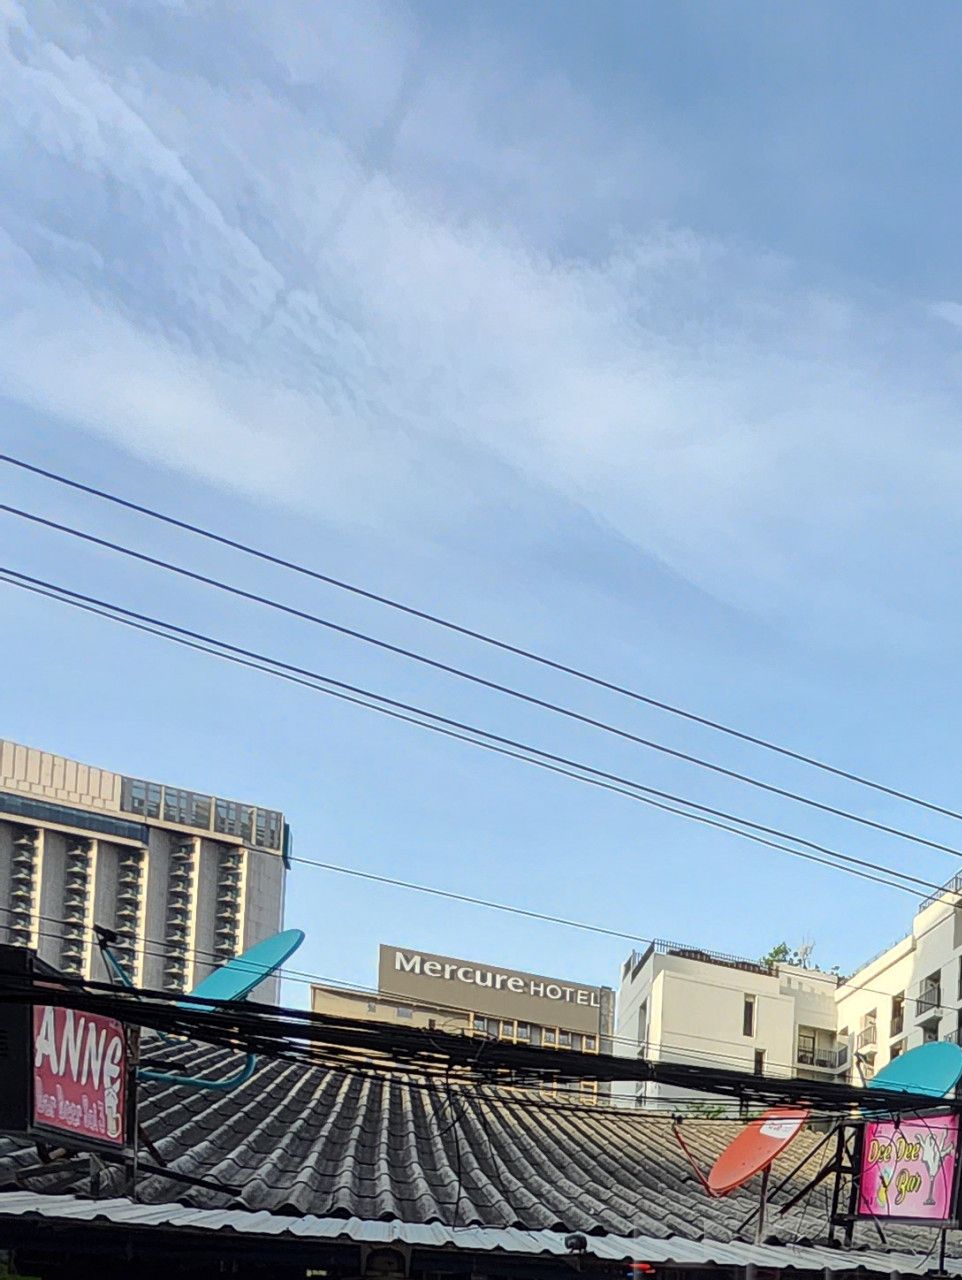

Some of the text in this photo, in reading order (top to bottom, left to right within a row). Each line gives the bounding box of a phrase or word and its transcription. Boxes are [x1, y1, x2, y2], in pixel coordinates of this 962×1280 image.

[394, 951, 600, 1008] Mercure HOTEL
[34, 1004, 123, 1092] ANNE
[868, 1136, 920, 1163] Dee Dee
[895, 1168, 922, 1205] Bar
